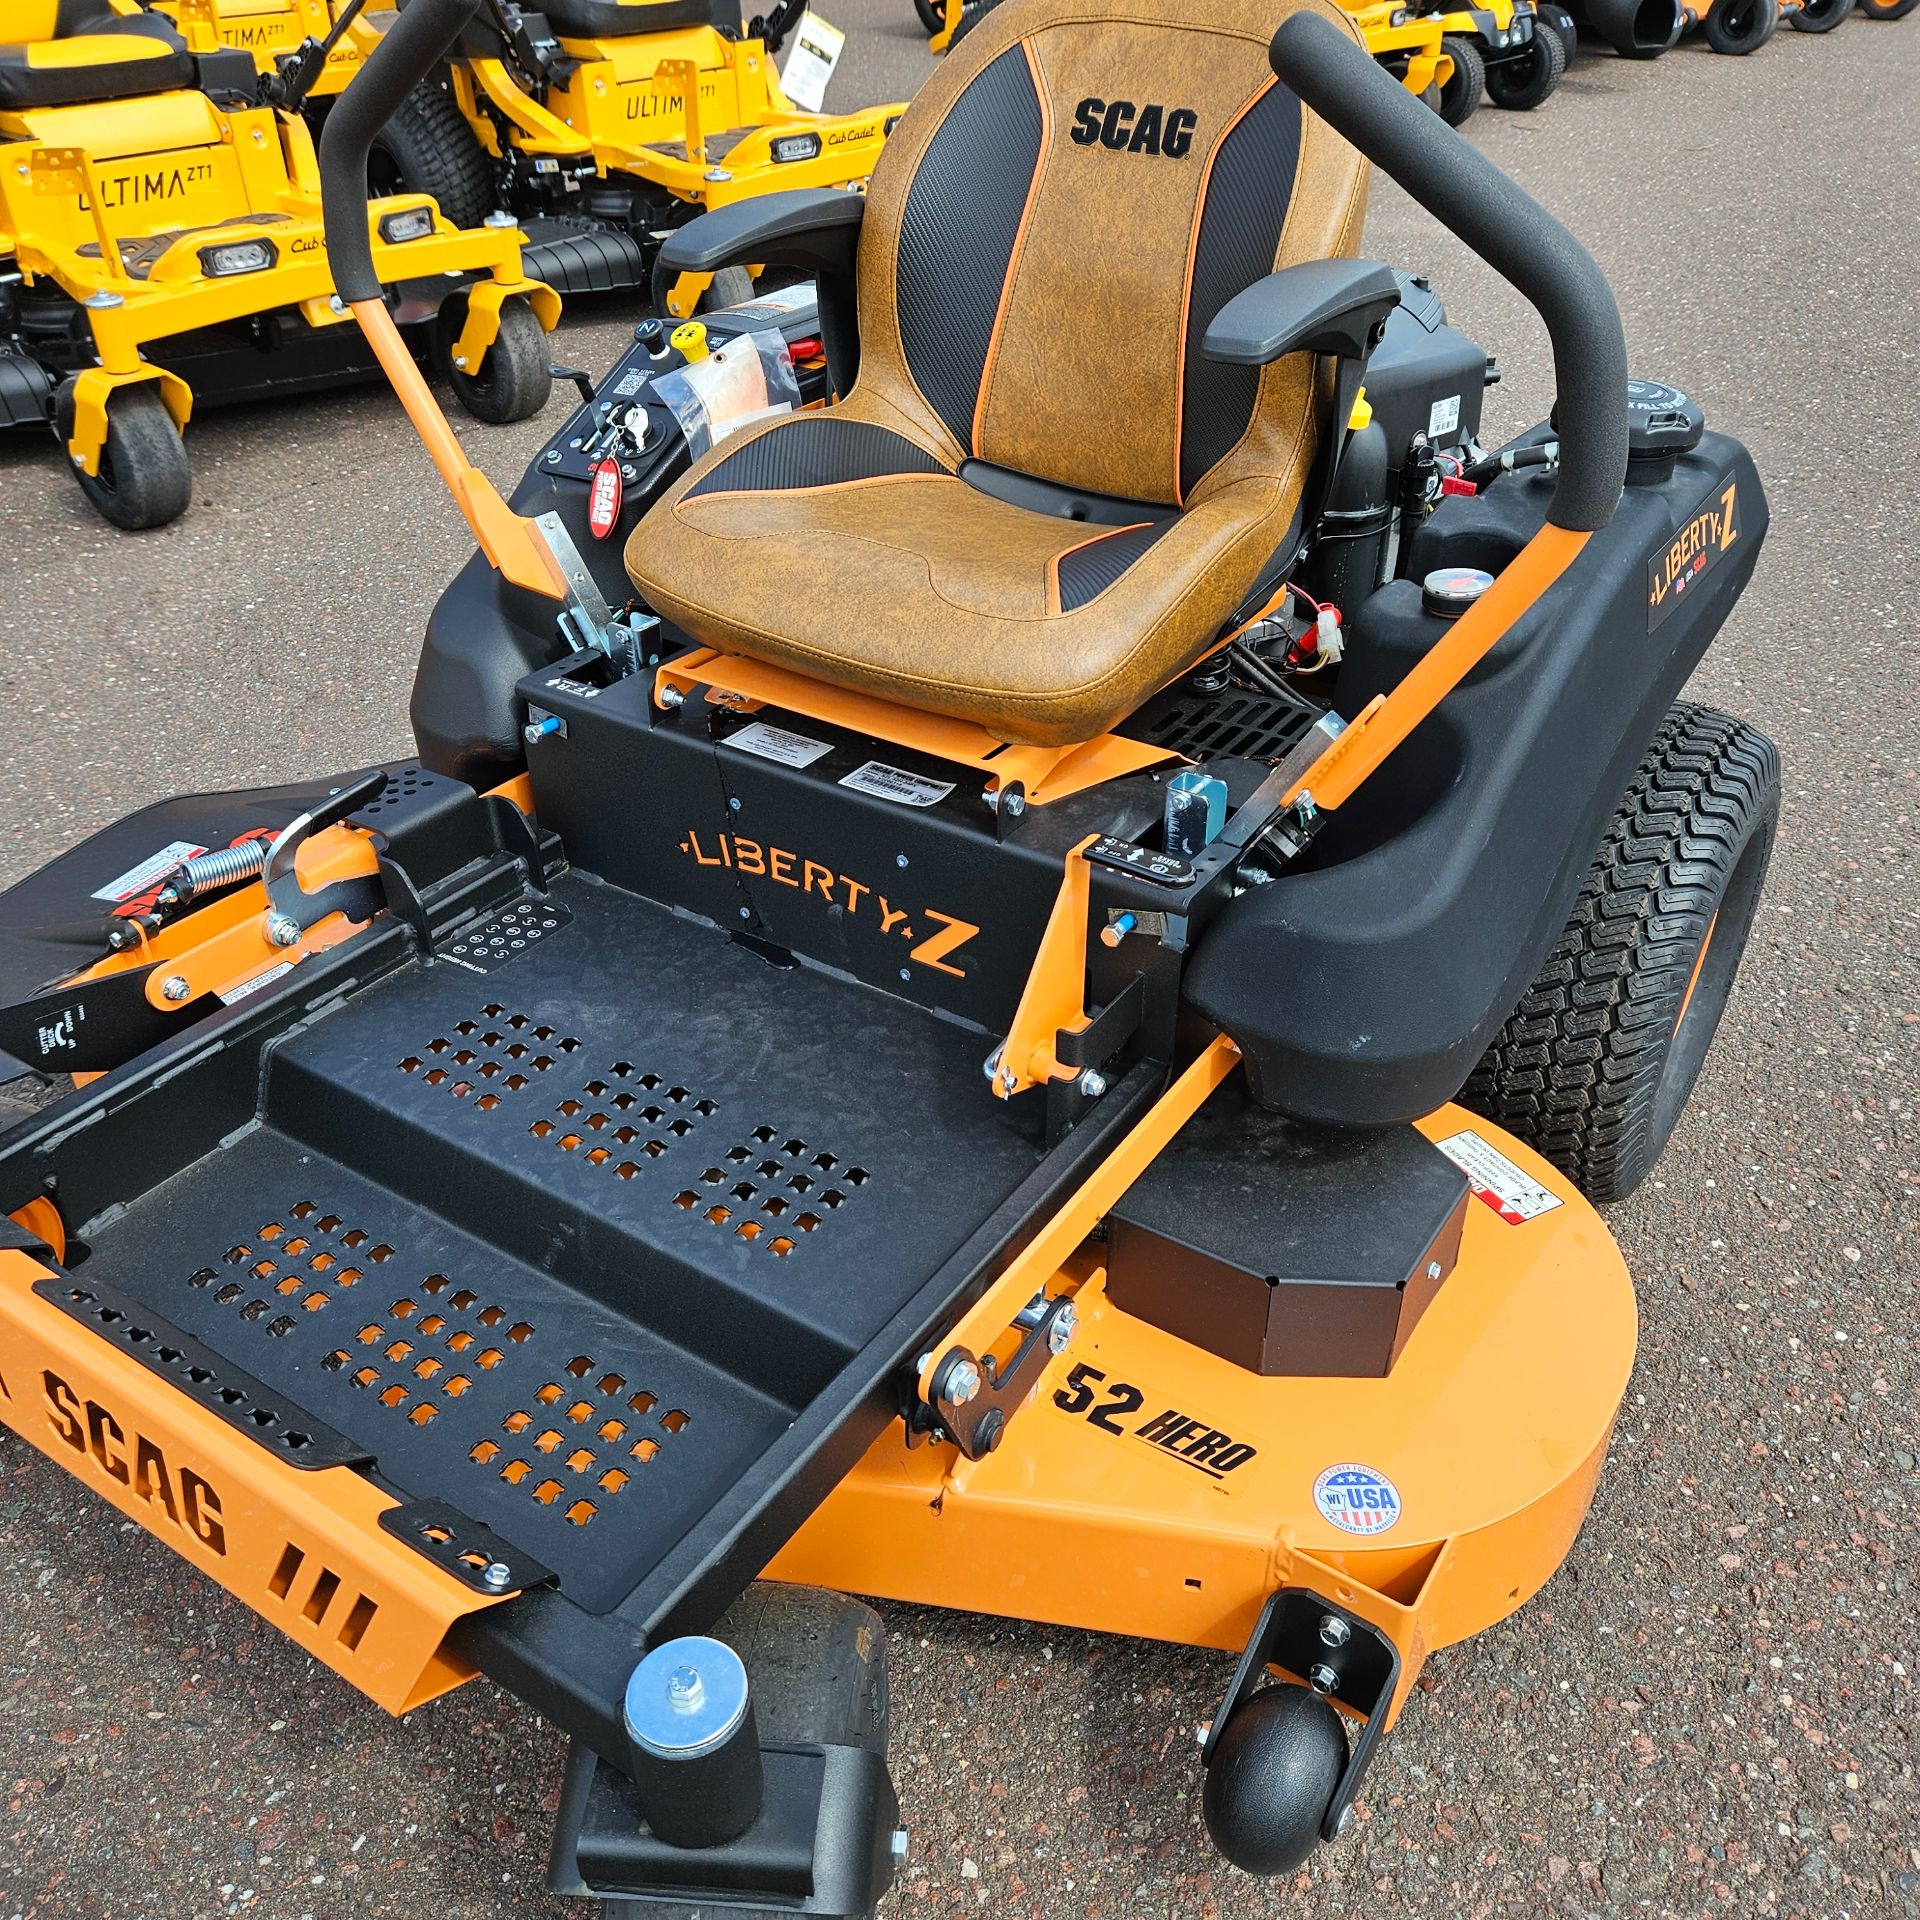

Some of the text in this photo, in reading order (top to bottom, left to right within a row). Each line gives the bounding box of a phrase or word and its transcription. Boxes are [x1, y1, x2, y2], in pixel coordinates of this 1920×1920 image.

[222, 24, 284, 48] TIMA ZT1
[626, 95, 684, 119] ULTIM
[828, 126, 876, 146] Cub Cadet
[1069, 97, 1198, 159] SCAG
[187, 164, 212, 182] ZT1
[291, 236, 319, 254] Cub
[597, 471, 618, 526] SCAG
[1654, 483, 1738, 606] LIBERTY Z
[688, 830, 981, 979] LIBERTY Z
[460, 961, 488, 974] CUTTING
[63, 1010, 74, 1033] DOWN
[38, 1026, 50, 1055] CUTTER
[46, 1027, 57, 1048] DECK
[67, 1038, 77, 1049] UP
[1443, 1145, 1506, 1194] SPINNING BLADES
[1483, 1156, 1508, 1176] CONTACT
[1052, 1362, 1258, 1473] 52 HERO
[39, 1368, 228, 1560] SCAG
[1327, 1465, 1351, 1476] POWER
[1353, 1465, 1390, 1487] EQUIPMENT
[1326, 1494, 1341, 1505] WI
[1346, 1487, 1397, 1509] USA
